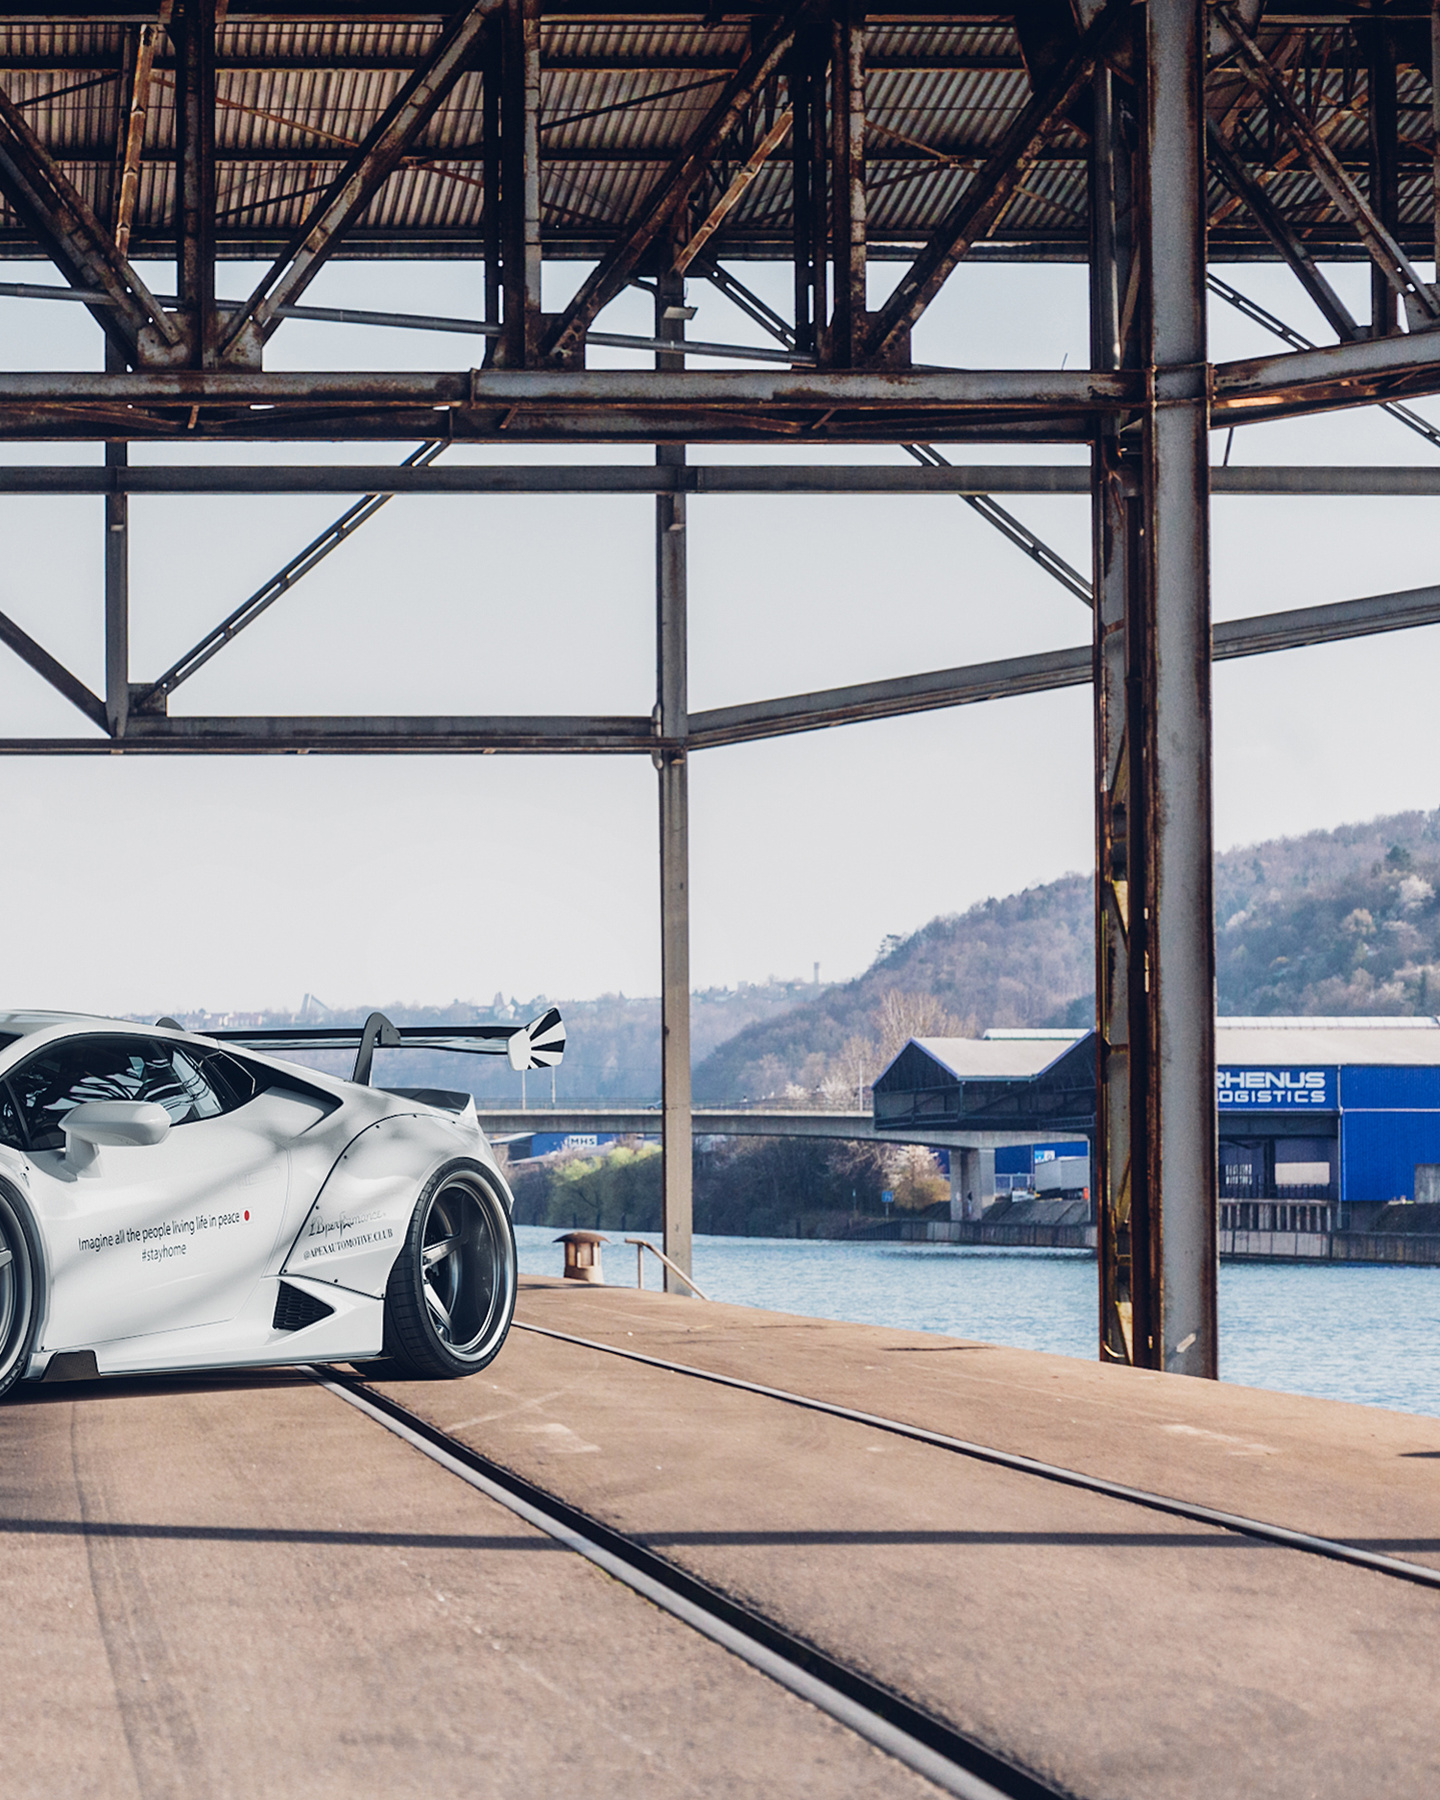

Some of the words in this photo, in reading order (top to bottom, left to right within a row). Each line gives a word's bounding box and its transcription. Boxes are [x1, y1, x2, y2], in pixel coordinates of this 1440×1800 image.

[1217, 1090, 1326, 1103] OGISTICS
[78, 1235, 114, 1252] Imagine
[115, 1229, 125, 1245] all
[126, 1227, 141, 1243] the
[142, 1221, 171, 1243] people
[171, 1219, 195, 1235] living
[196, 1214, 208, 1230] life
[209, 1214, 217, 1228] in
[218, 1212, 240, 1229] peace
[141, 1244, 187, 1262] #stayhome
